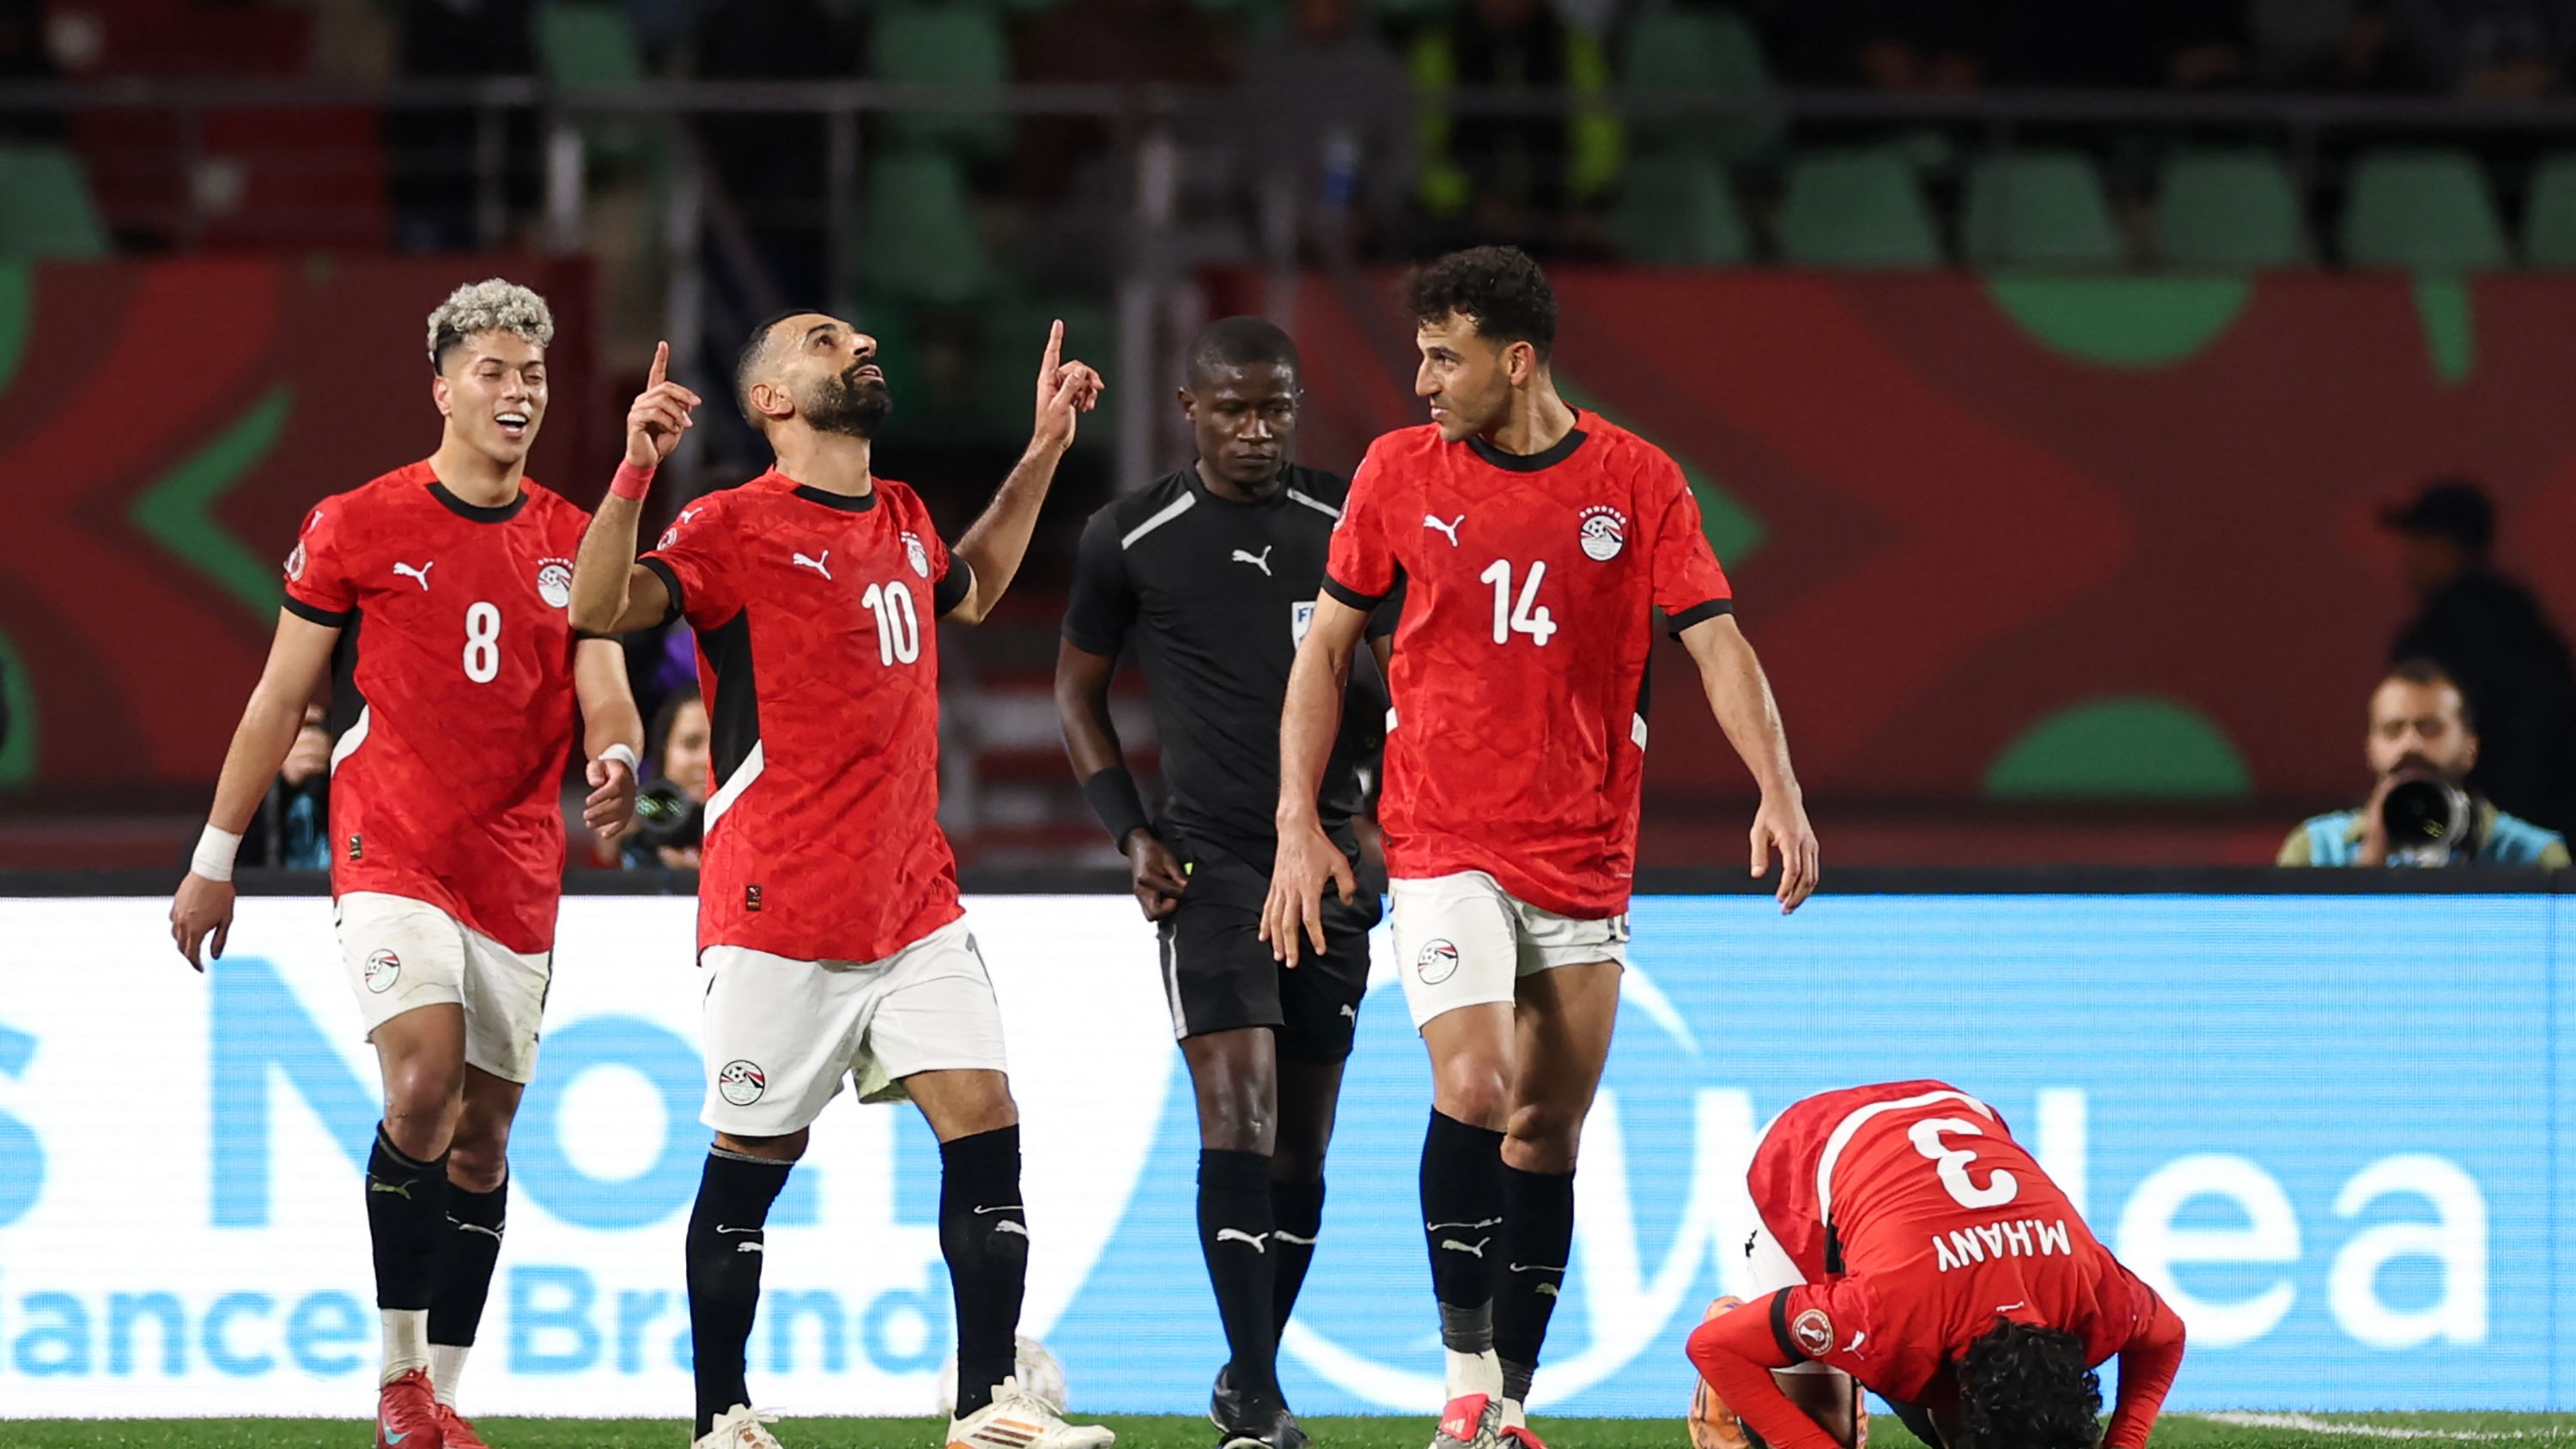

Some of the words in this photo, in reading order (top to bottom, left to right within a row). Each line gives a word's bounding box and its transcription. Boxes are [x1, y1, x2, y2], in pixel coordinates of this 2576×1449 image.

[463, 602, 501, 683] 8
[861, 580, 919, 666] 10
[1480, 559, 1557, 646] 14
[1907, 1118, 2018, 1210] 3
[1932, 1219, 2071, 1272] M.HANY
